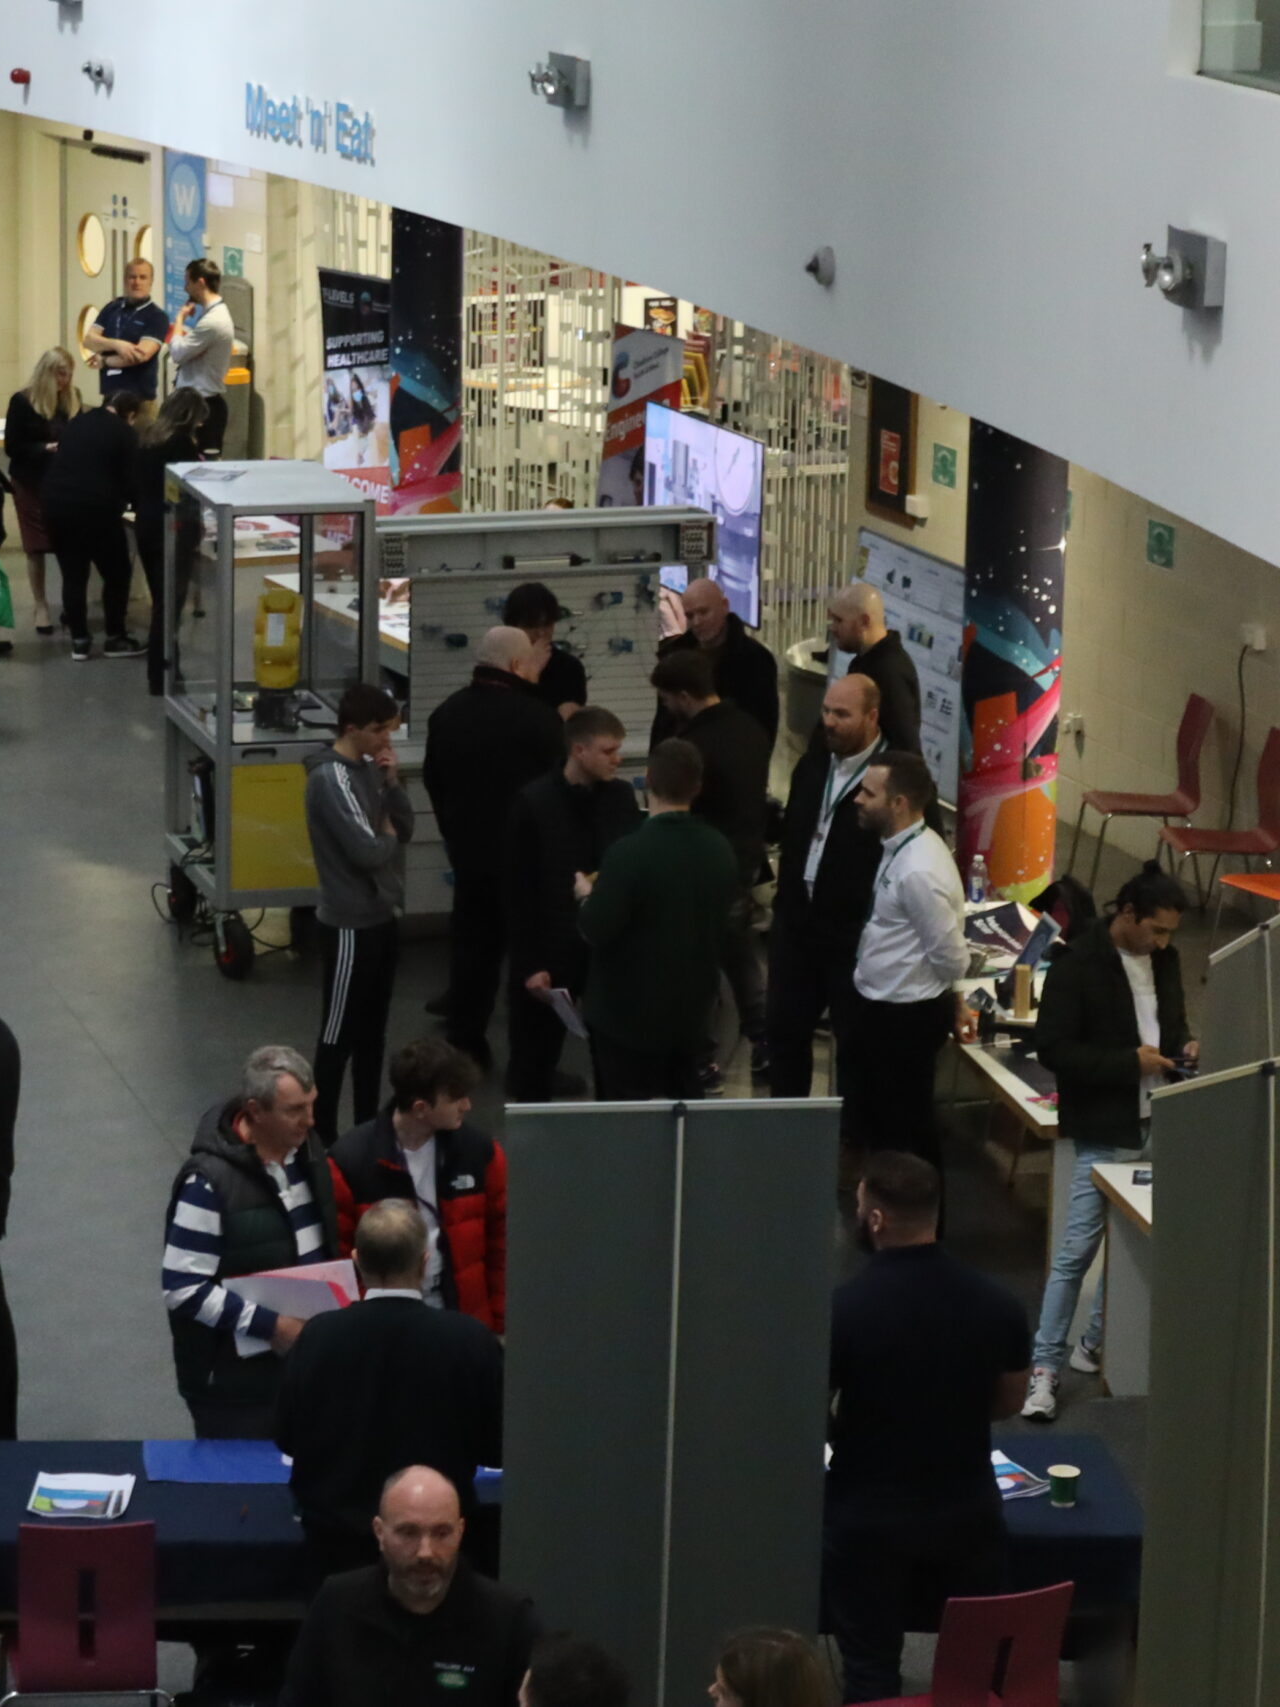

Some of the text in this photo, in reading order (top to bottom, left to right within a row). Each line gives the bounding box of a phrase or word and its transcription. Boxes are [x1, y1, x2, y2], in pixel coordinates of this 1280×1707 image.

[245, 82, 299, 142] Meet
[336, 102, 373, 160] Eat
[173, 183, 196, 217] W
[326, 348, 389, 368] HEALTHCARE
